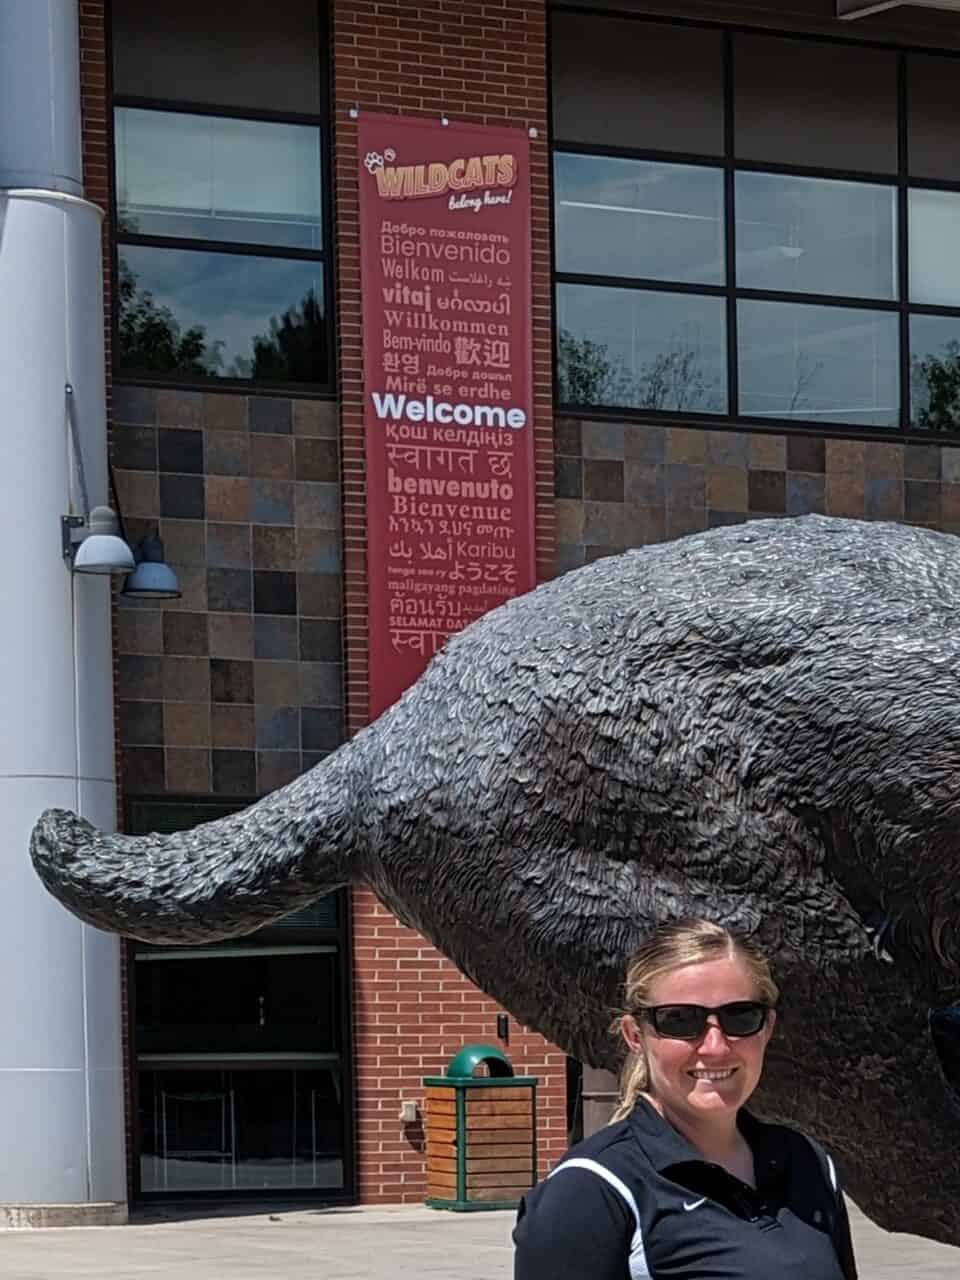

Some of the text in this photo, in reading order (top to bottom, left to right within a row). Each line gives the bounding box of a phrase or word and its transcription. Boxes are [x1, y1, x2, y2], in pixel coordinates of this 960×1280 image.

[376, 154, 515, 198] WILDCATS
[448, 189, 512, 212] belong here!
[381, 220, 426, 237] Добро
[381, 235, 511, 264] Bienvenido
[382, 258, 444, 283] Welkom
[382, 282, 432, 312] vitaj
[383, 309, 509, 336] Willkommen
[383, 329, 451, 353] Bem-vindo
[454, 335, 511, 368] 歡迎
[382, 352, 420, 375] 환영
[385, 376, 512, 400] Mirë se erdhe
[371, 392, 526, 428] Welcome
[386, 443, 479, 474] स्वागत
[387, 467, 513, 500] benvenuto
[392, 494, 512, 520] Bienvenue
[456, 541, 516, 559] Karibu
[448, 560, 518, 583] ようこそ
[389, 615, 442, 629] SELAMAT
